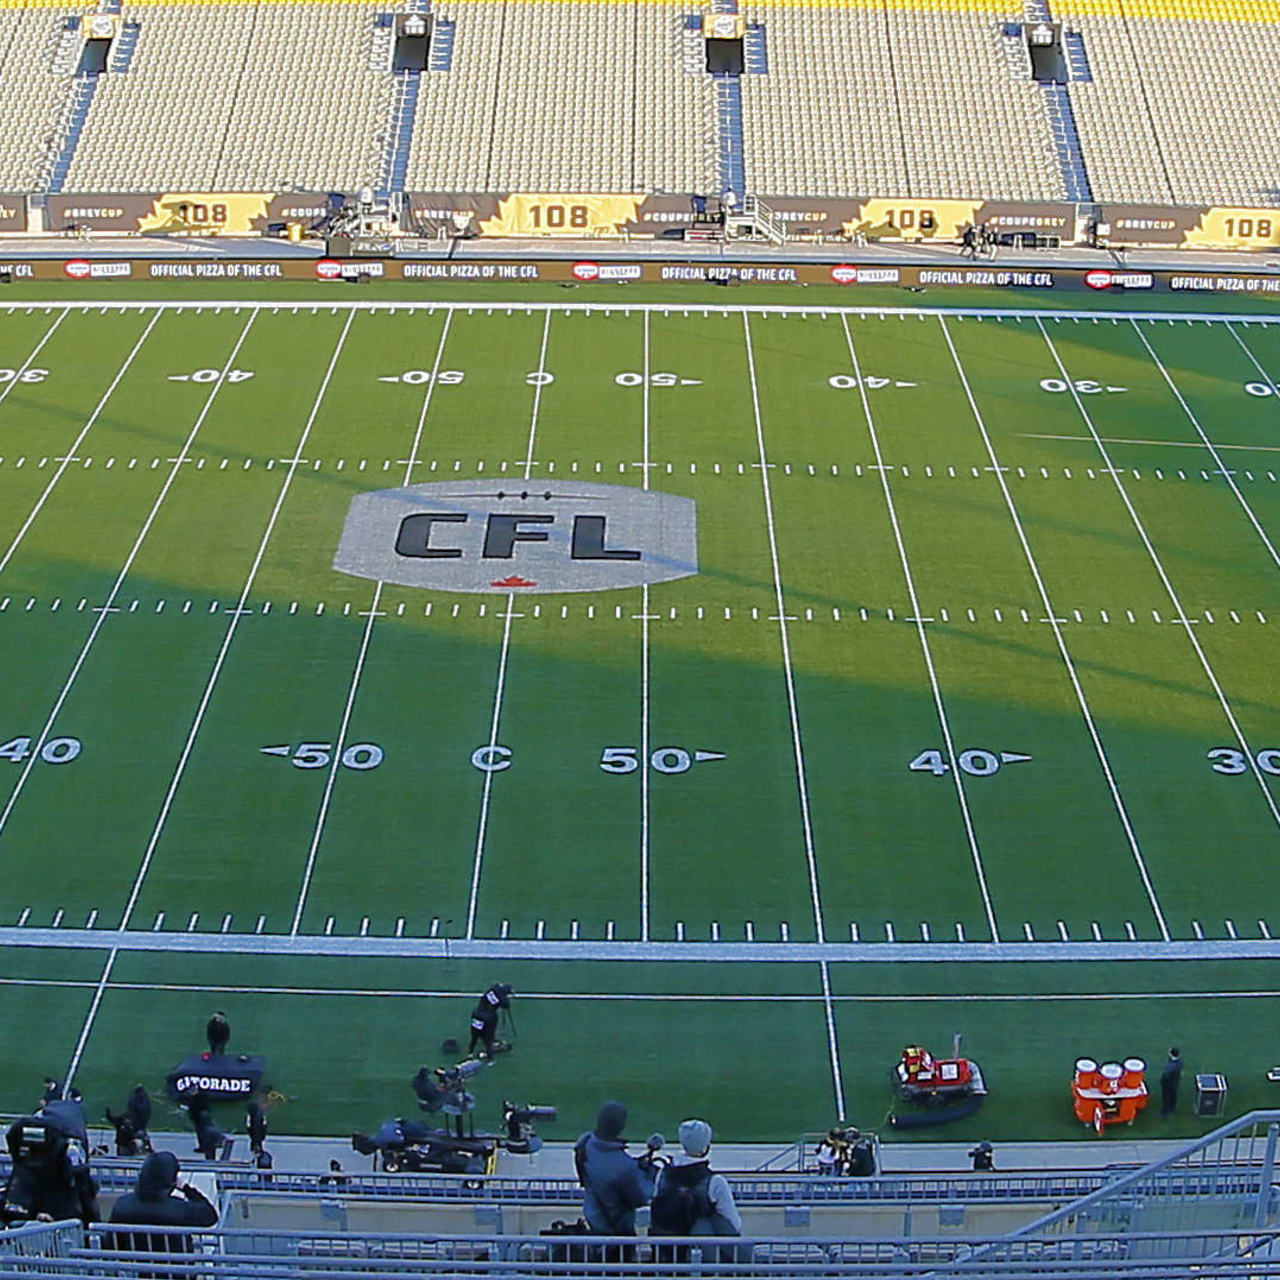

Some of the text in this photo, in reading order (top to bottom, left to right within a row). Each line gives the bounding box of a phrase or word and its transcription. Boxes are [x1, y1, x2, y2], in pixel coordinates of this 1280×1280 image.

[180, 204, 228, 223] 108
[529, 204, 589, 228] 108
[885, 209, 935, 230] 108
[1225, 218, 1272, 238] 108
[15, 265, 34, 277] CFL
[151, 263, 282, 277] OFFICIAL PIZZA OF THE CFL
[404, 264, 538, 278] OFFICIAL PIZZA OF THE CFL
[662, 266, 706, 280] OFFICIAL
[740, 268, 754, 280] OF
[756, 268, 776, 280] THE
[778, 268, 797, 281] CFL
[919, 270, 1053, 286] OFFICIAL PIZZA OF THE CFL
[1171, 276, 1214, 290] OFFICIAL
[1216, 277, 1244, 291] PIZZA
[1246, 279, 1260, 291] OF
[1261, 279, 1280, 292] THE
[192, 368, 255, 384] 40
[402, 370, 466, 386] 50
[525, 371, 554, 386] C
[614, 372, 679, 387] 50
[828, 373, 892, 390] 40
[1038, 377, 1103, 394] 30
[395, 512, 642, 562] CFL
[291, 742, 386, 770] 50
[469, 744, 513, 773] C
[599, 746, 693, 774] 50
[908, 748, 1002, 776] 40
